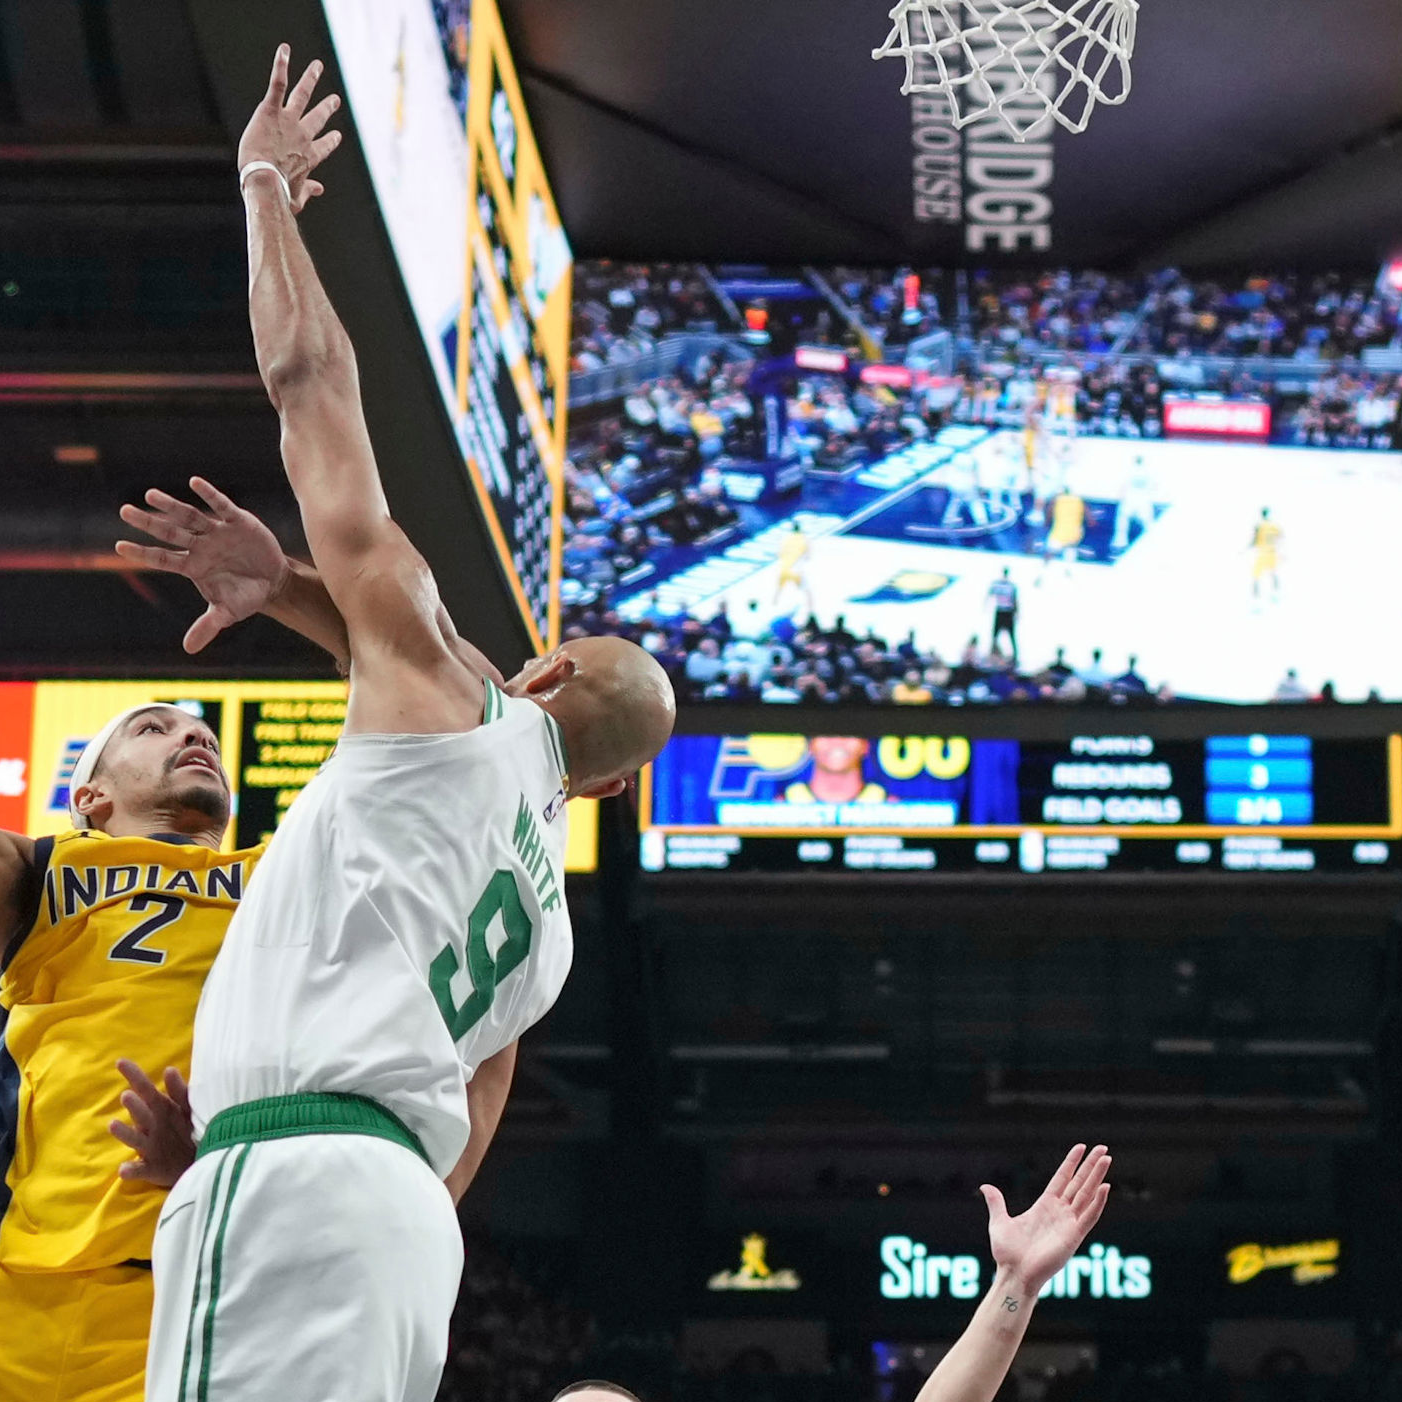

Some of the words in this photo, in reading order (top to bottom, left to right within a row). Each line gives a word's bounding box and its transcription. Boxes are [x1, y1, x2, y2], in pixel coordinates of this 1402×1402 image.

[965, 0, 1056, 251] INBRIDGE
[1043, 796, 1103, 824] FIELD
[1103, 796, 1182, 824] GOALS
[1052, 763, 1172, 790] REBOUNDS
[512, 790, 562, 914] WHITE
[46, 862, 244, 927] INDIAN
[108, 893, 185, 966] 2
[429, 869, 532, 1044] 9
[881, 1236, 979, 1299] Sire
[1038, 1243, 1151, 1298] irits
